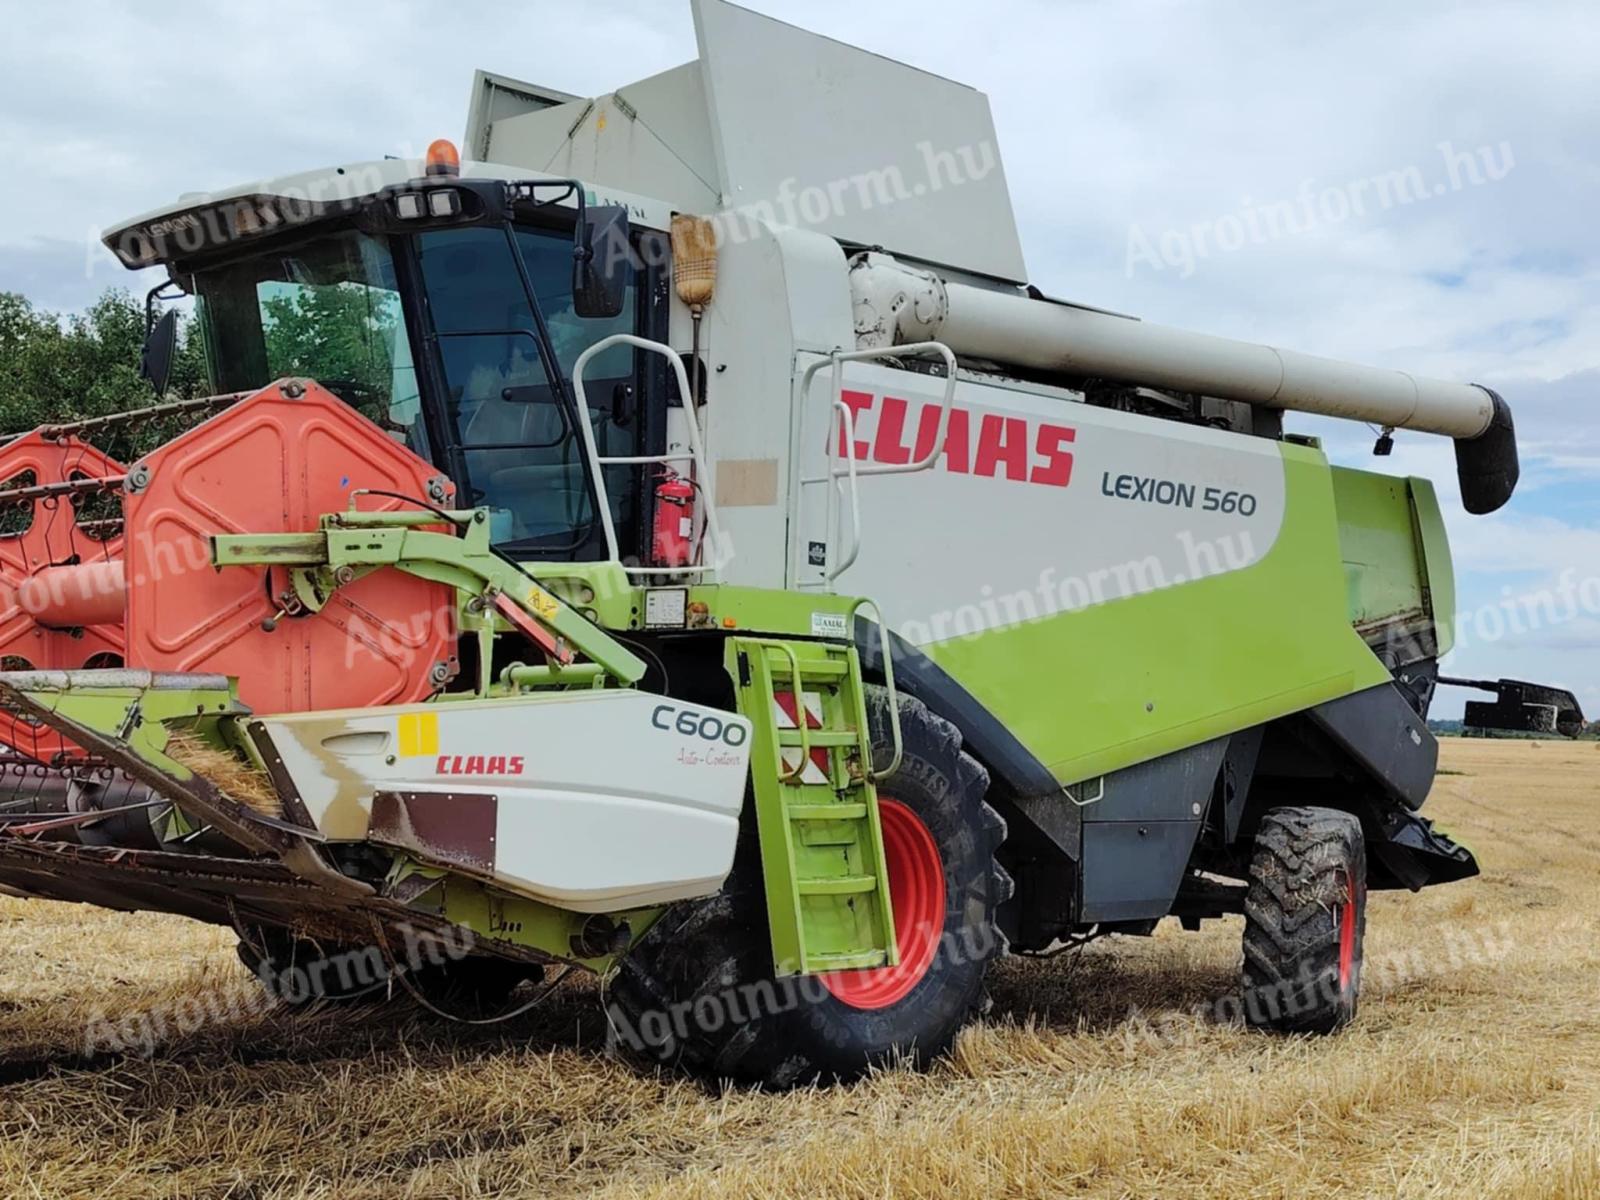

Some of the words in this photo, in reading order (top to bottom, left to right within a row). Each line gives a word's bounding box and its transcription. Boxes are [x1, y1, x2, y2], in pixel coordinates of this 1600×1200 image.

[826, 389, 1076, 488] CLAAS
[1102, 471, 1196, 508] LEXION
[1202, 487, 1257, 517] 560
[651, 704, 747, 747] C600
[436, 755, 525, 775] CLAAS
